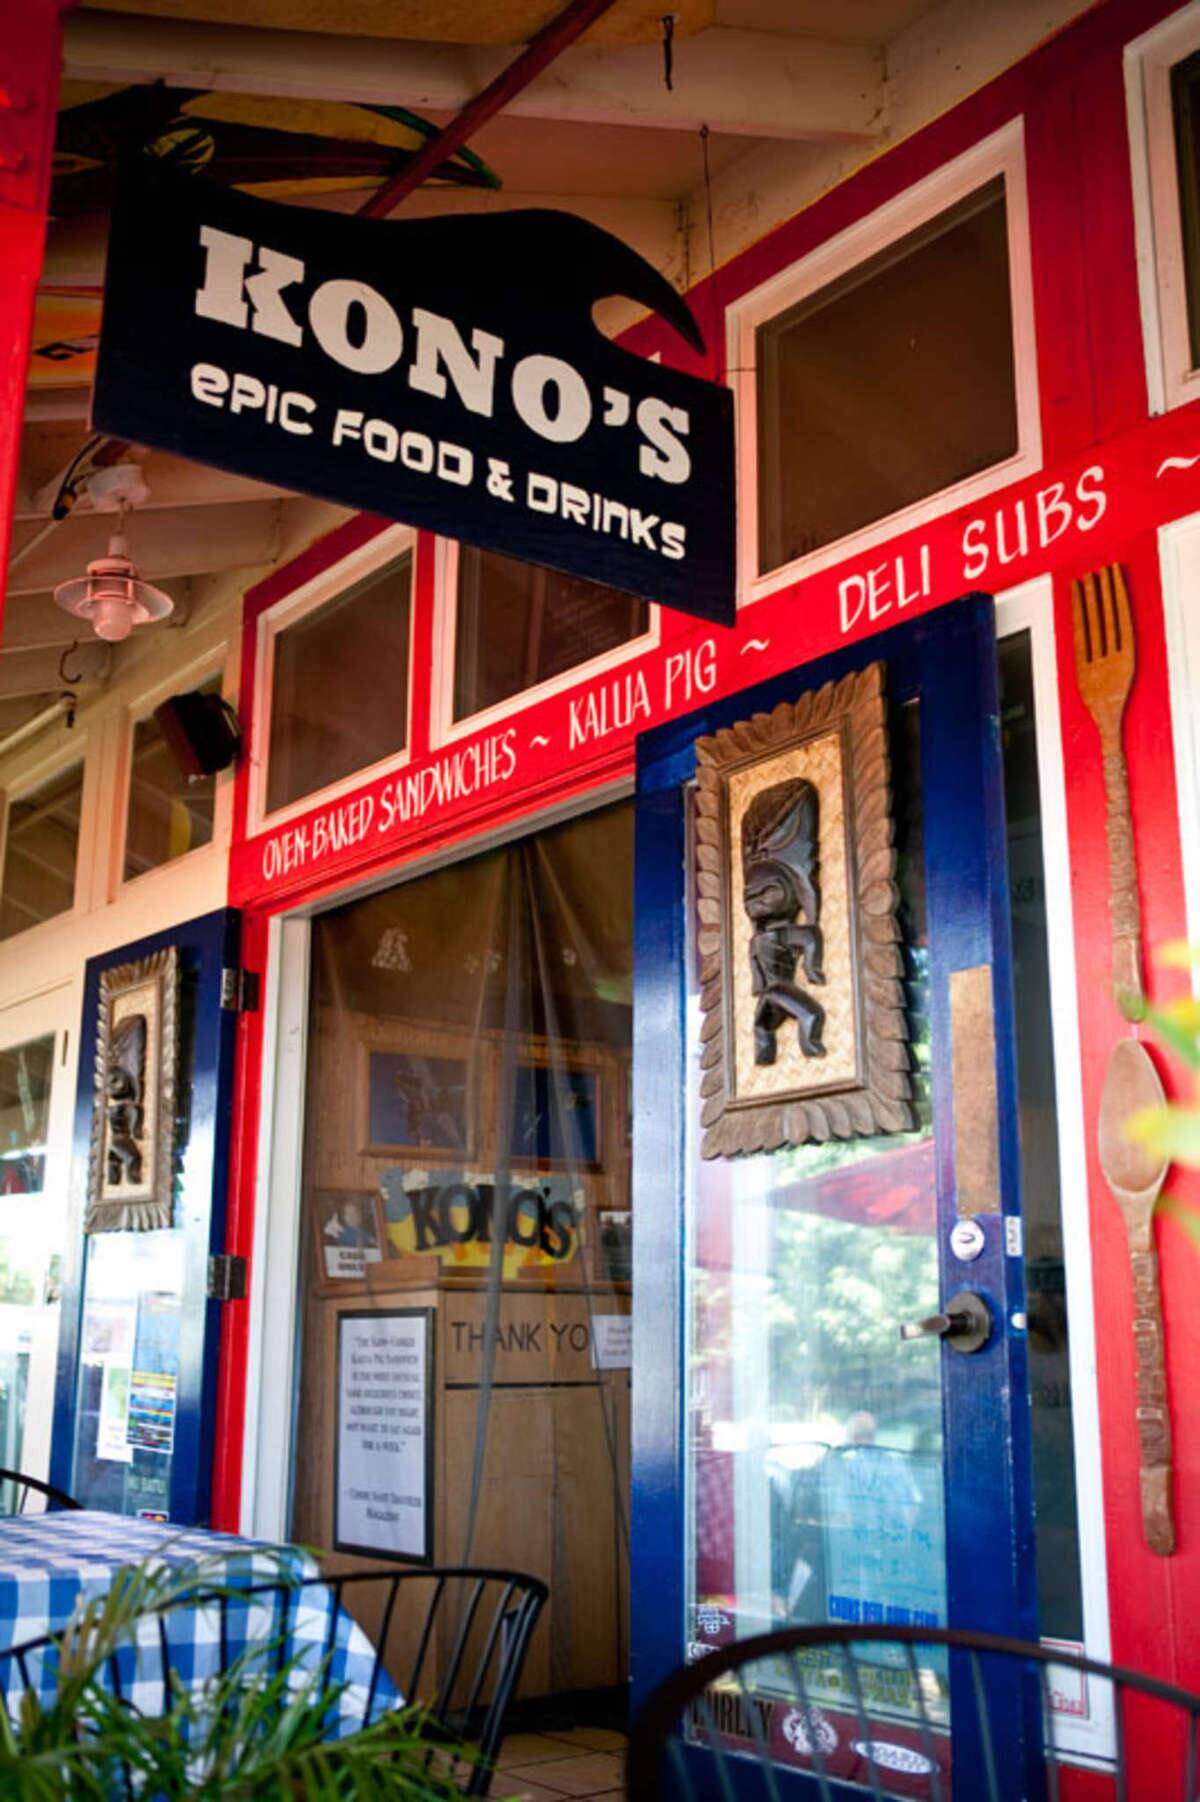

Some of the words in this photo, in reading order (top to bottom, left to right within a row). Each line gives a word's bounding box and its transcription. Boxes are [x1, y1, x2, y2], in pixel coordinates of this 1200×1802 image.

[195, 226, 691, 484] KONO'S
[332, 409, 474, 486] FOOD
[486, 457, 515, 502] &
[262, 795, 374, 881] OVEN-BAKED
[378, 728, 517, 833] SANDWICHES
[568, 671, 652, 750] KALUA
[665, 640, 717, 710] PIG
[838, 544, 931, 633] DELI
[962, 465, 1107, 580] SUBS
[451, 1322, 541, 1352] THANK
[550, 1323, 589, 1352] YO
